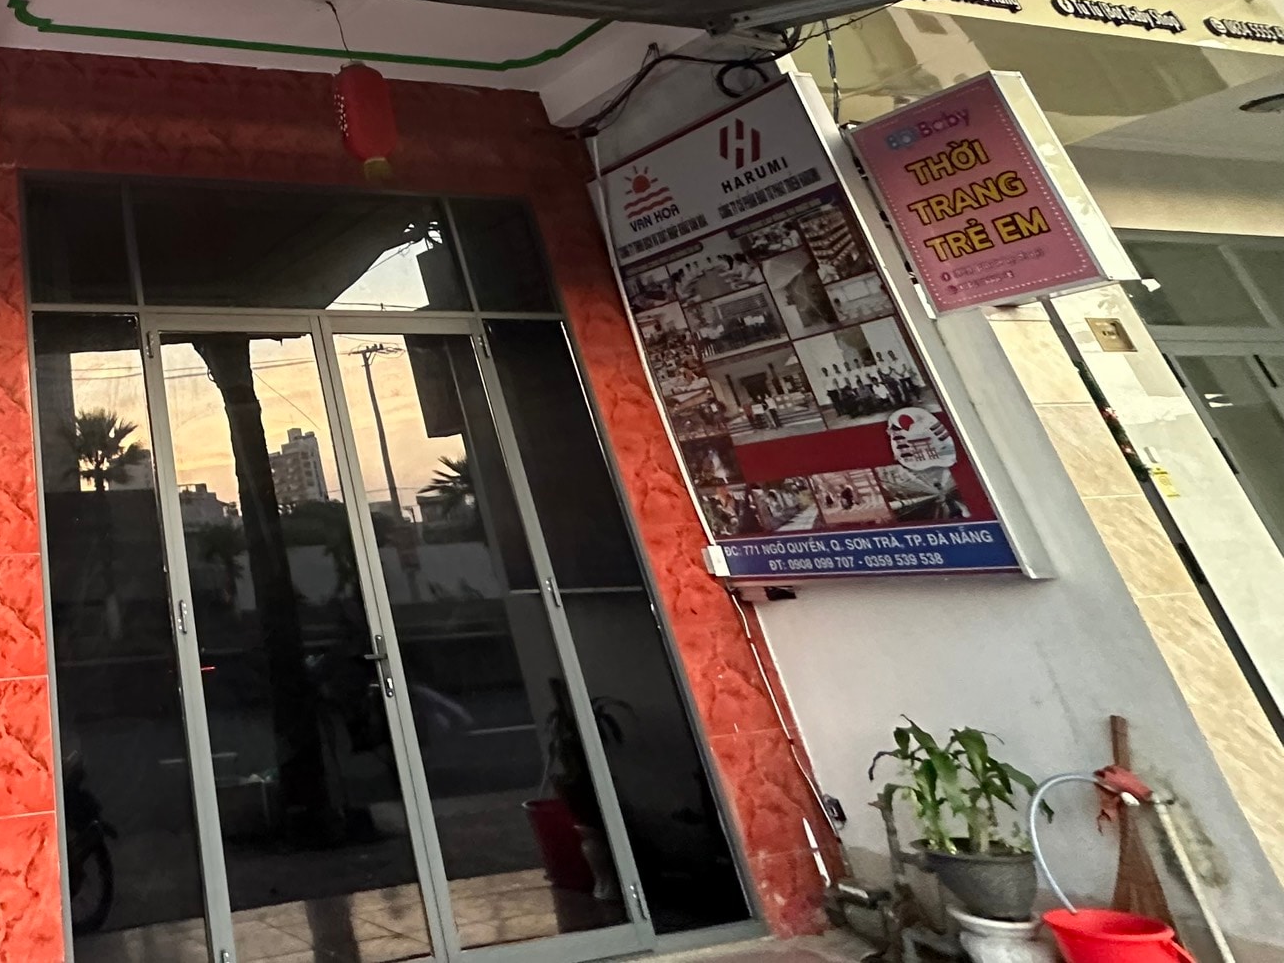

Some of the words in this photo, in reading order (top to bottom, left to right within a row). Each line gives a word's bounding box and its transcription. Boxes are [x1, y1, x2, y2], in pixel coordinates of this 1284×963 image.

[721, 157, 789, 194] HARUMI
[905, 139, 990, 186] THỜI
[907, 170, 1028, 226] TRANG
[923, 218, 995, 262] TRẺ
[992, 206, 1052, 244] EM
[743, 544, 761, 556] 771
[904, 535, 927, 548] TP.
[927, 529, 949, 546] ĐÀ
[835, 556, 855, 568] 707
[865, 554, 893, 567] 0359
[894, 552, 917, 566] 539
[917, 551, 944, 565] 538
